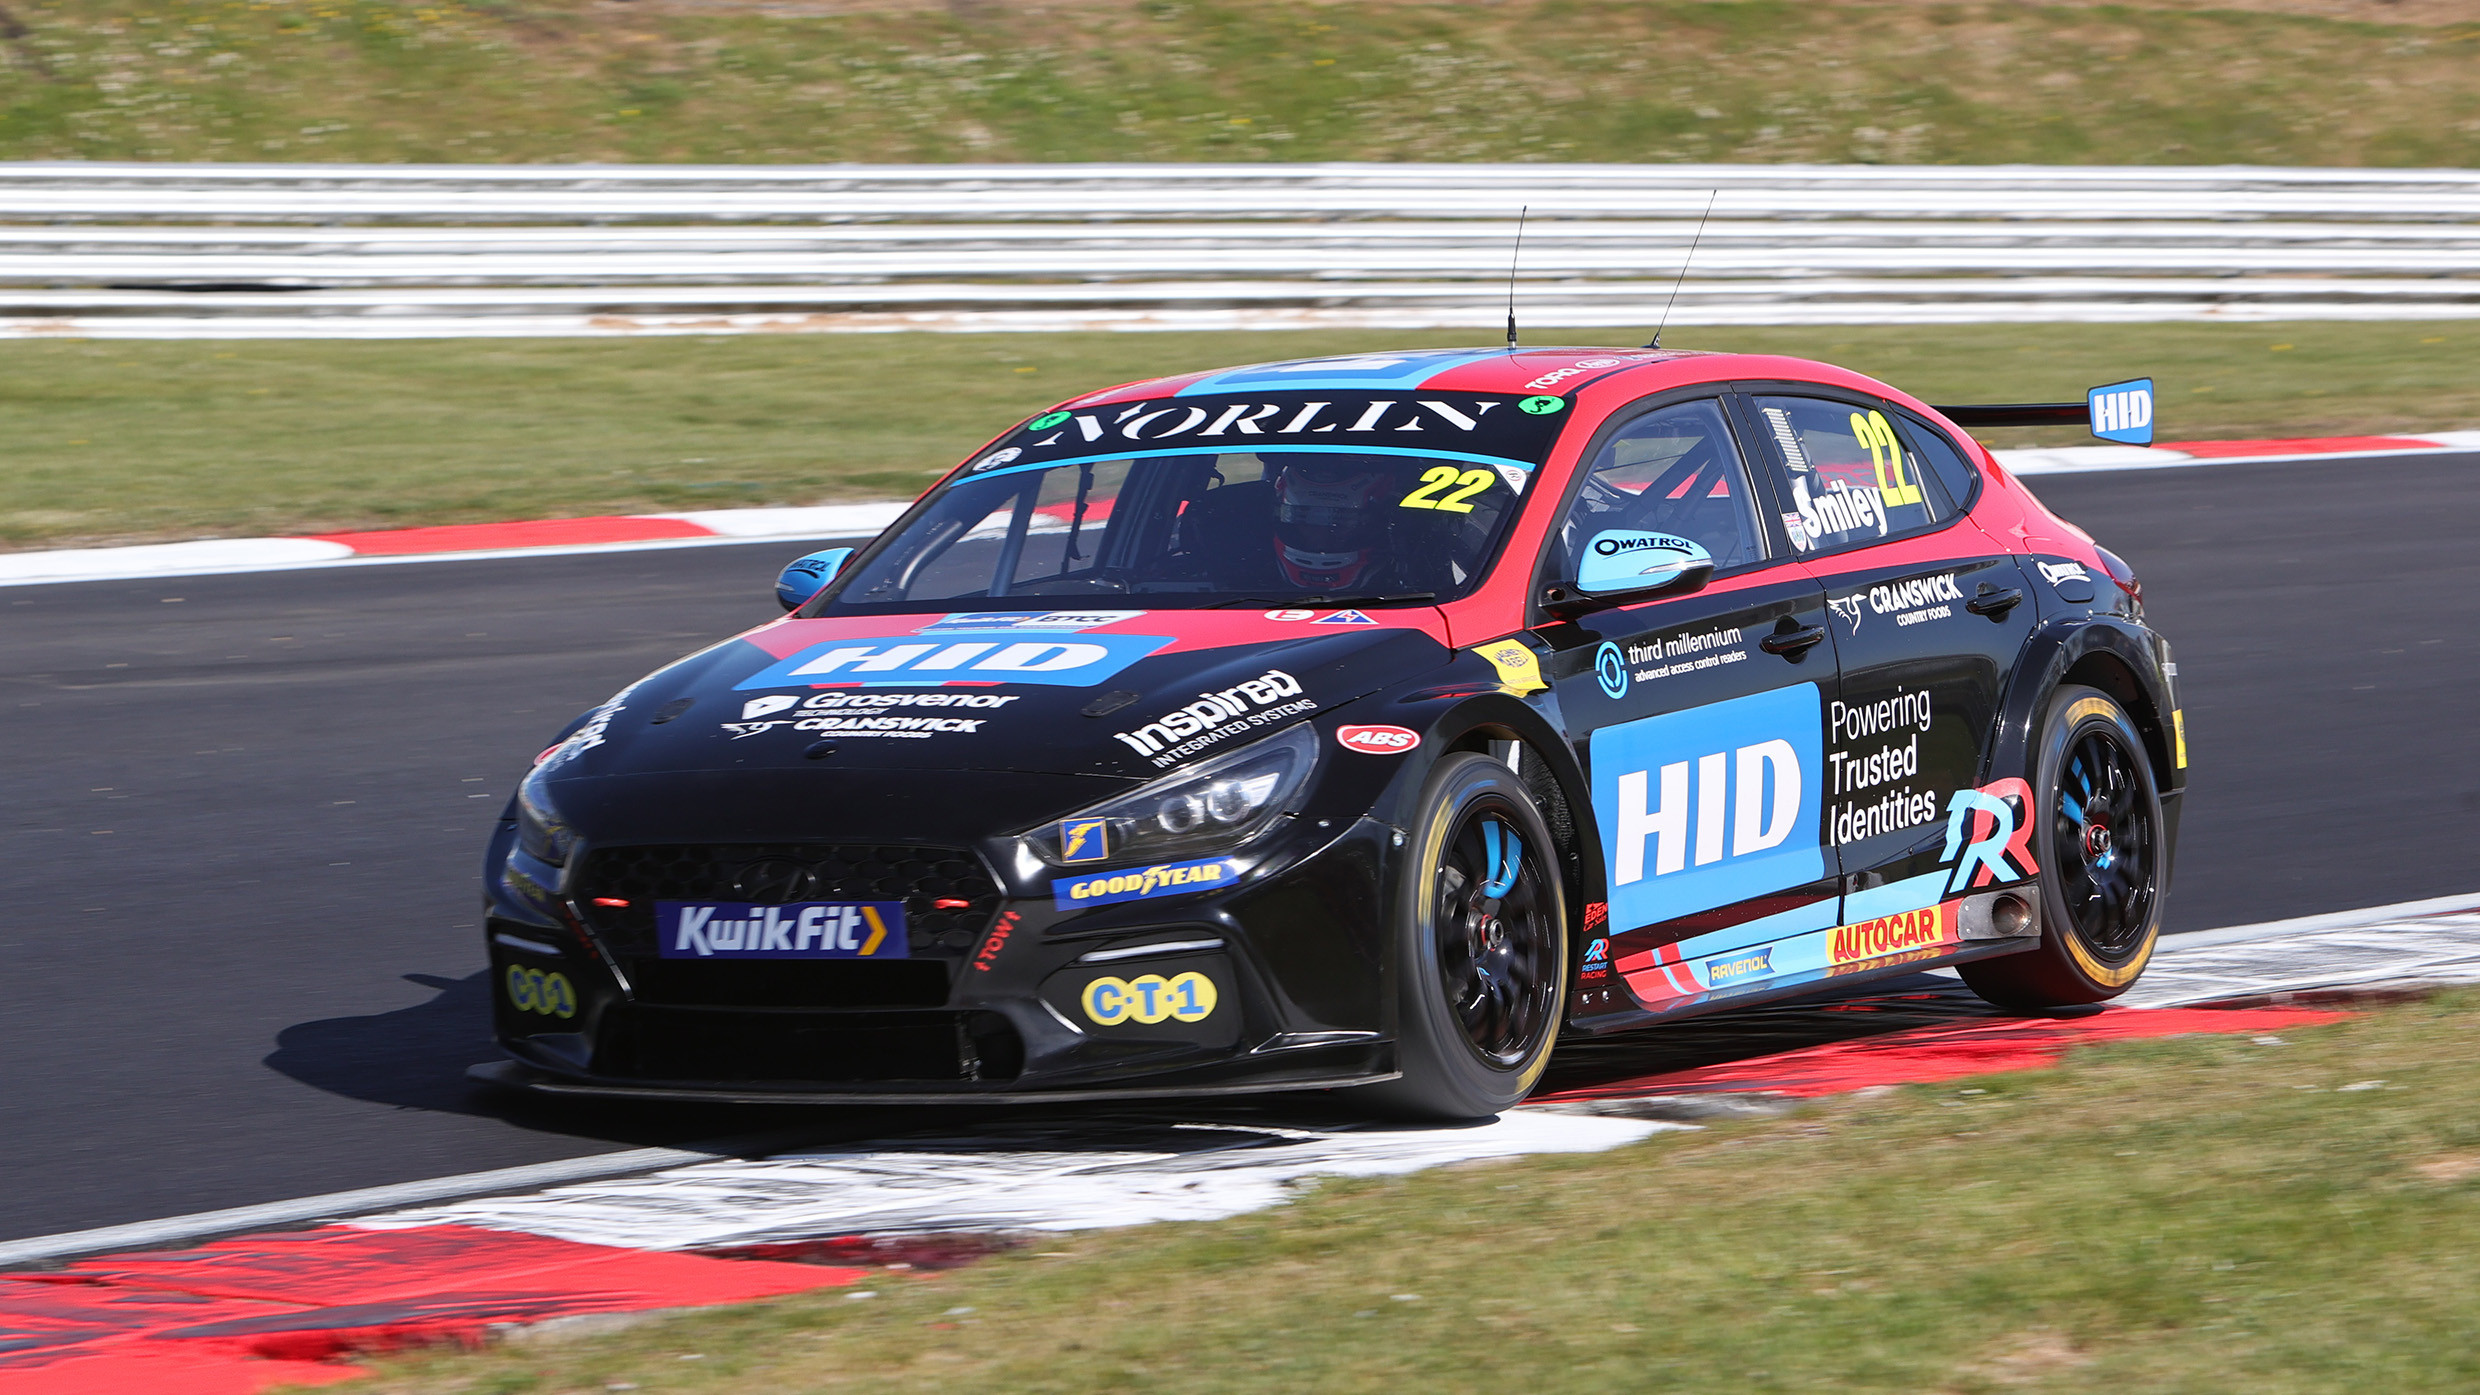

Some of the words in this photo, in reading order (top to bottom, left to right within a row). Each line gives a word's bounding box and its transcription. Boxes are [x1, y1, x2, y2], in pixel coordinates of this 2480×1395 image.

[1032, 400, 1501, 447] NORLIN
[2093, 389, 2152, 433] HID
[1850, 410, 1922, 508] 22
[1399, 466, 1495, 513] 22
[1792, 479, 1888, 538] Smiley
[1594, 538, 1693, 556] OWATROL
[1869, 573, 1964, 615] CRANSWICK
[1896, 610, 1928, 627] COUNTRY
[1928, 605, 1952, 619] FOODS
[787, 642, 1108, 676] HID
[1628, 638, 1663, 664] third
[1666, 627, 1742, 657] millennium
[1634, 664, 1669, 682] advanced
[1670, 661, 1695, 675] access
[1695, 654, 1720, 670] control
[1720, 650, 1747, 664] readers
[802, 692, 1020, 708] Grosvenor
[1113, 669, 1304, 757] inspired
[1830, 686, 1931, 744] Powering
[793, 717, 987, 733] CRANSWICK
[1151, 721, 1250, 768] INTEGRATED
[1247, 698, 1318, 726] SYSTEMS
[1347, 732, 1412, 748] ABS
[1829, 734, 1918, 795] Trusted
[1614, 738, 1802, 887] HID
[1830, 789, 1936, 846] Identities
[1070, 864, 1222, 900] GOODYEAR
[1584, 903, 1608, 924] EDEN
[977, 917, 1015, 960] TOW
[1834, 909, 1935, 962] AUTOCAR
[1581, 970, 1608, 980] RACING
[1582, 962, 1608, 972] RESTART
[1711, 955, 1769, 980] RAVENOL
